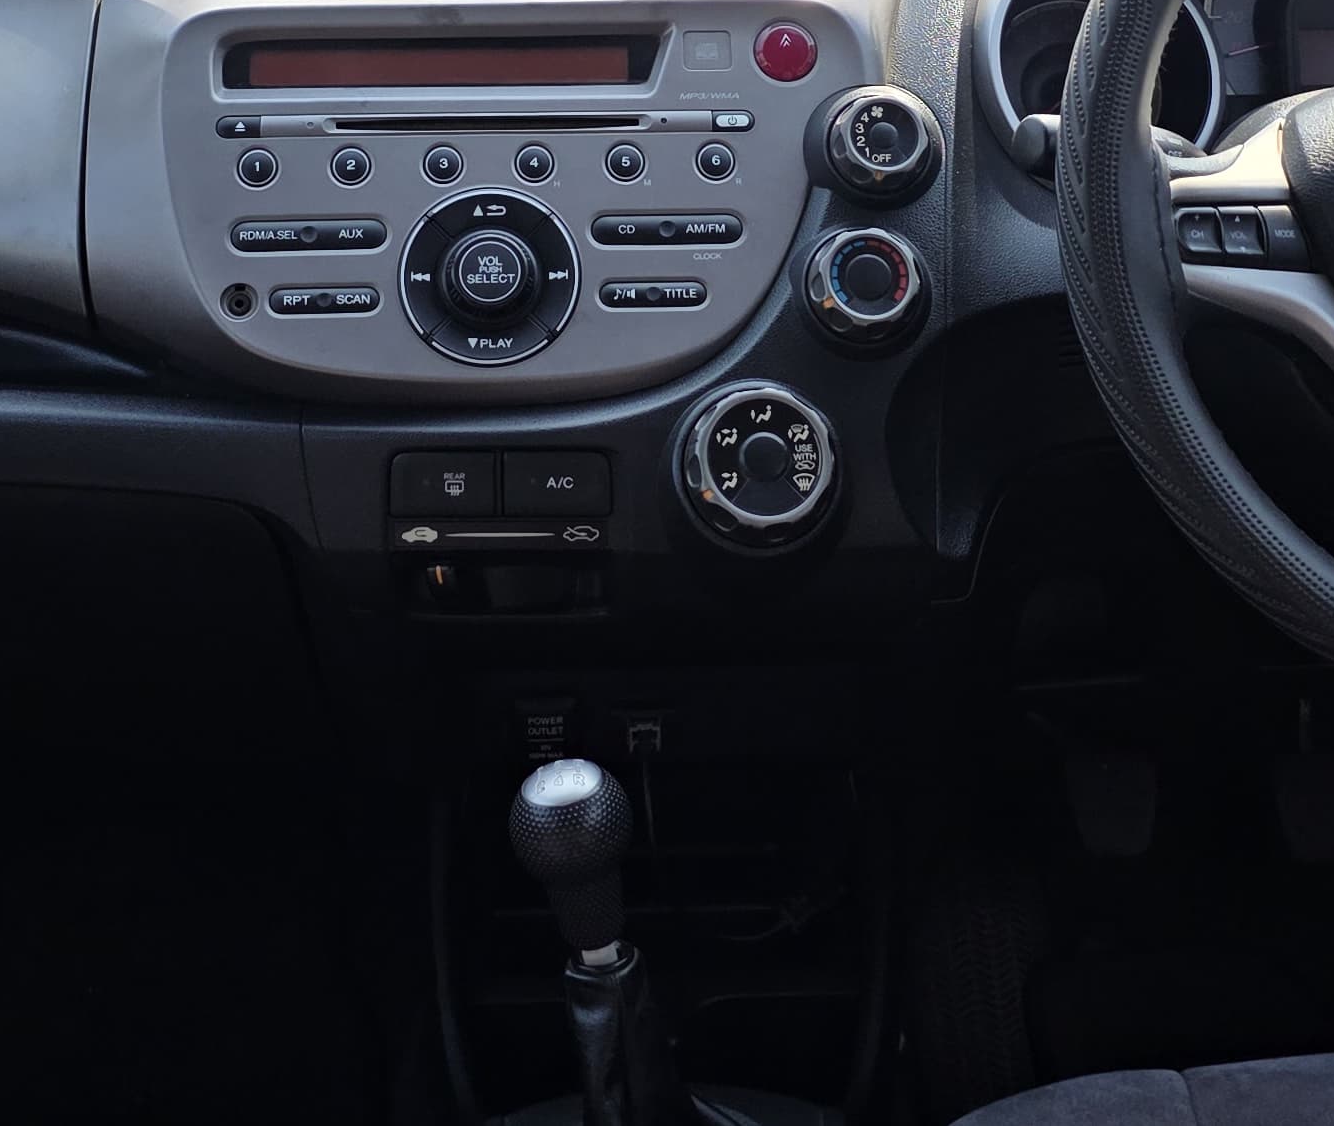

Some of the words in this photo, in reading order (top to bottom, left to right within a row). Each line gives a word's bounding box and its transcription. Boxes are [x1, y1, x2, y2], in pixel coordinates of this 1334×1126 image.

[679, 91, 740, 100] MP3/WMA
[860, 112, 870, 123] 4
[855, 123, 864, 134] 3
[856, 136, 866, 147] 2
[865, 147, 870, 158] 1
[439, 158, 449, 169] 3
[529, 157, 540, 168] 4
[621, 156, 631, 167] 5
[711, 155, 721, 166] 6
[871, 154, 892, 163] OFF
[254, 161, 261, 172] 1
[346, 159, 356, 171] 2
[338, 228, 364, 239] AUX
[618, 223, 636, 234] CD
[685, 223, 726, 234] AM/FM
[1274, 229, 1296, 239] MODE
[477, 256, 503, 266] VOL
[692, 252, 722, 261] CLOCK
[479, 266, 503, 274] PUSH
[466, 273, 516, 285] SELECT
[663, 288, 697, 299] TITLE
[282, 295, 311, 306] RPT
[336, 294, 371, 305] SCAN
[479, 337, 514, 348] PLAY
[794, 443, 813, 453] USE
[792, 452, 817, 461] WITH
[443, 472, 466, 480] REAR
[546, 476, 574, 489] A/C
[527, 716, 563, 725] POWER
[527, 726, 563, 735] OUTLET
